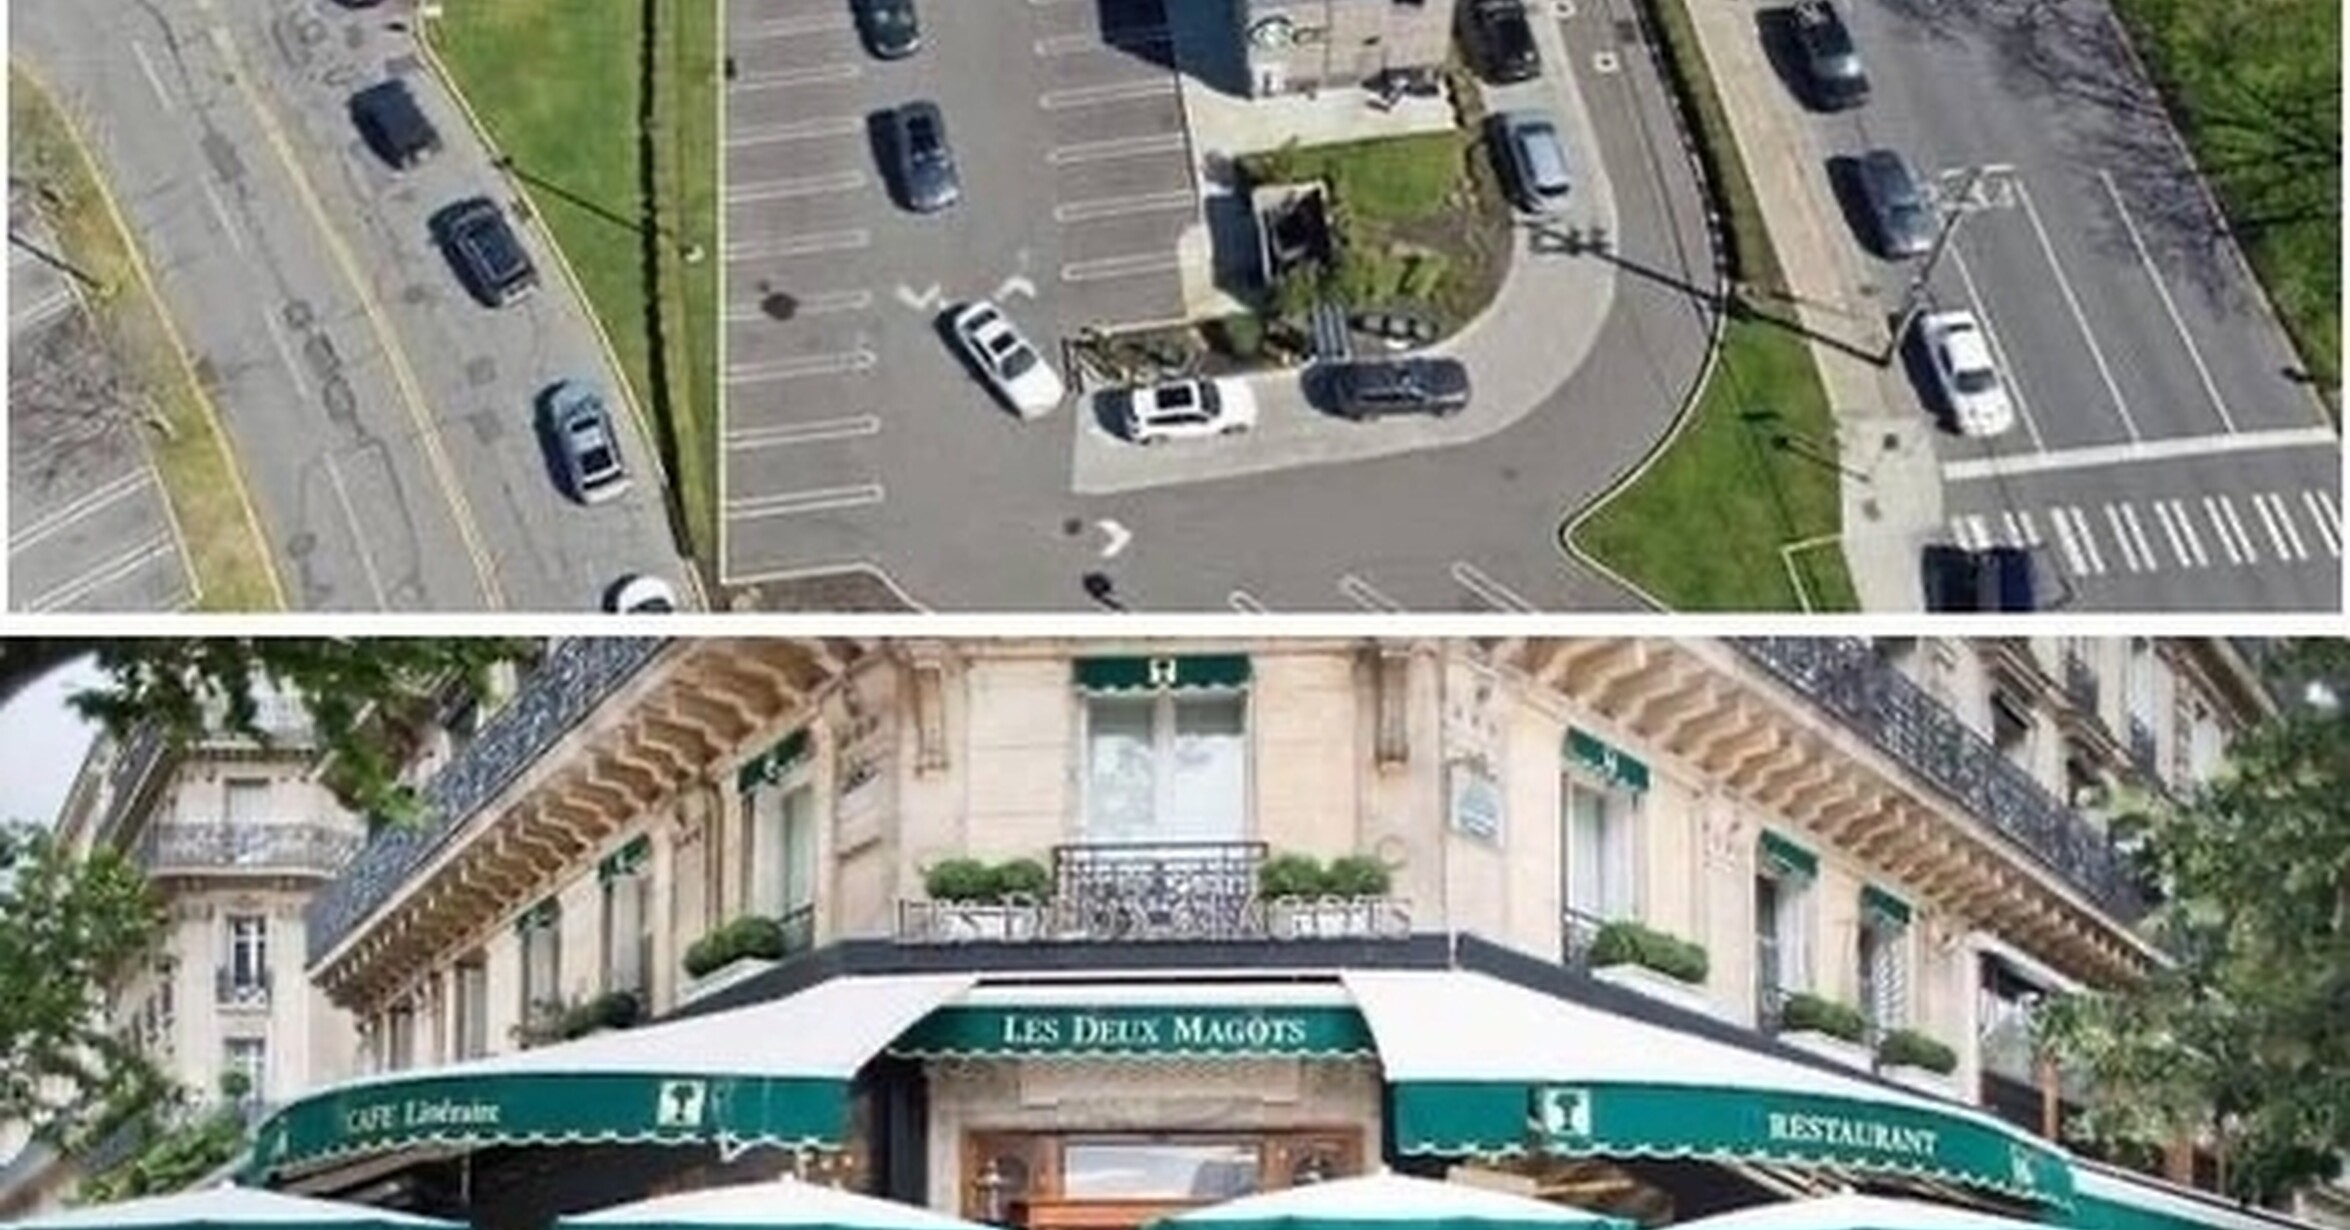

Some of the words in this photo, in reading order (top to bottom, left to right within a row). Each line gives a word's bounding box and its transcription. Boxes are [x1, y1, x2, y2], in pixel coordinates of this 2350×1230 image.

[1003, 1015, 1059, 1044] LES
[1073, 1015, 1160, 1044] DEUX
[1768, 1112, 1938, 1157] RESTAURANT
